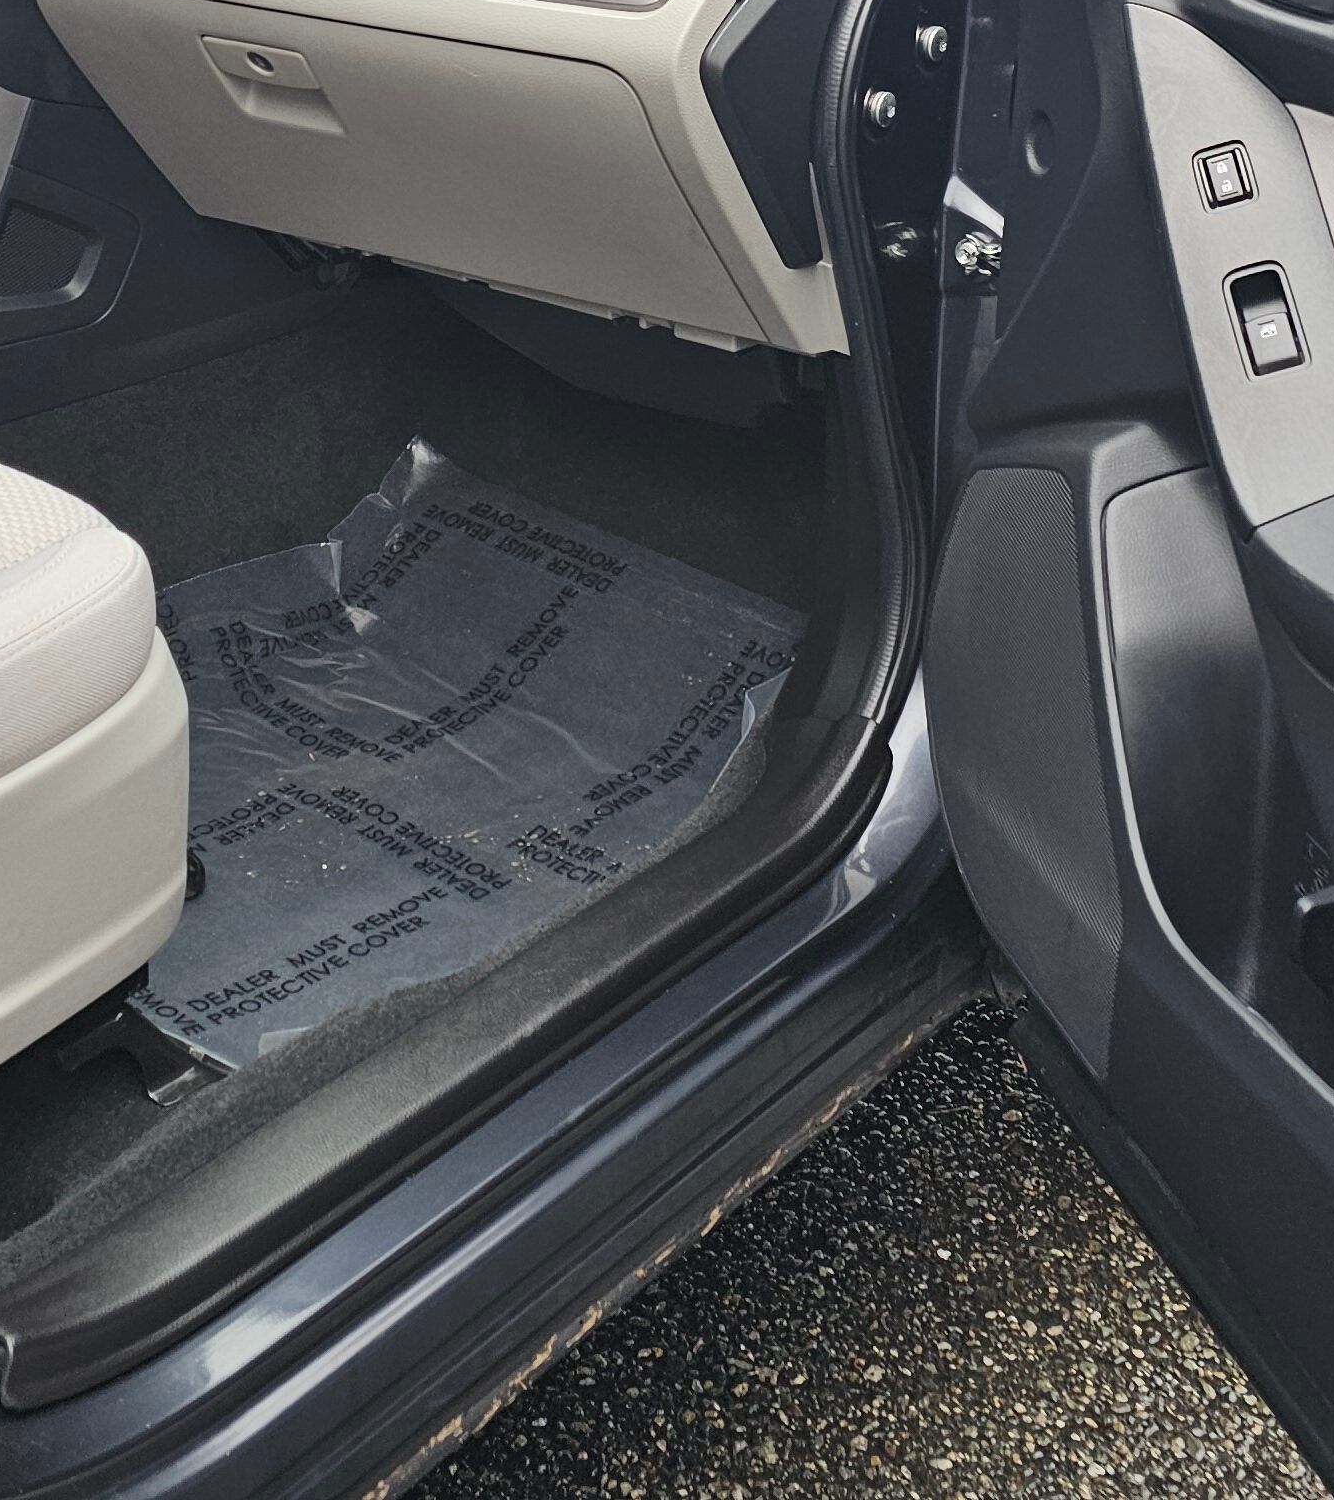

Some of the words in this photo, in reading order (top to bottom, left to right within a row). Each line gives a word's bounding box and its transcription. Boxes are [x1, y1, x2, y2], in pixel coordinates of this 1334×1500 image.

[423, 503, 495, 543] REMOVE
[468, 500, 529, 534] COVER
[379, 529, 443, 589] DEALER
[496, 536, 545, 563] MUST
[528, 527, 628, 577] PROTECTIVE
[546, 562, 614, 594] DEALER
[459, 663, 507, 704] MUST
[506, 585, 579, 660] REMOVE
[507, 624, 571, 689] COVER
[210, 626, 289, 728] PROTECTIVE
[285, 725, 351, 760] COVER
[648, 660, 746, 767] PROTECTIVE
[275, 697, 327, 726] MUST
[324, 726, 405, 764] REMOVE
[582, 763, 652, 802] COVER
[654, 745, 703, 785] MUST
[191, 792, 278, 838] PROTEC
[276, 782, 358, 825] REMOVE
[569, 784, 654, 838] REMOVE
[356, 823, 415, 859] MUST
[394, 821, 513, 890] PROTECTIVE
[412, 857, 492, 902] DEALER
[186, 968, 281, 1014] DEALER
[286, 933, 348, 970] MUST
[351, 885, 449, 935] REMOVE
[208, 953, 351, 1026] PROTECTIVE
[347, 915, 431, 958] COVER
